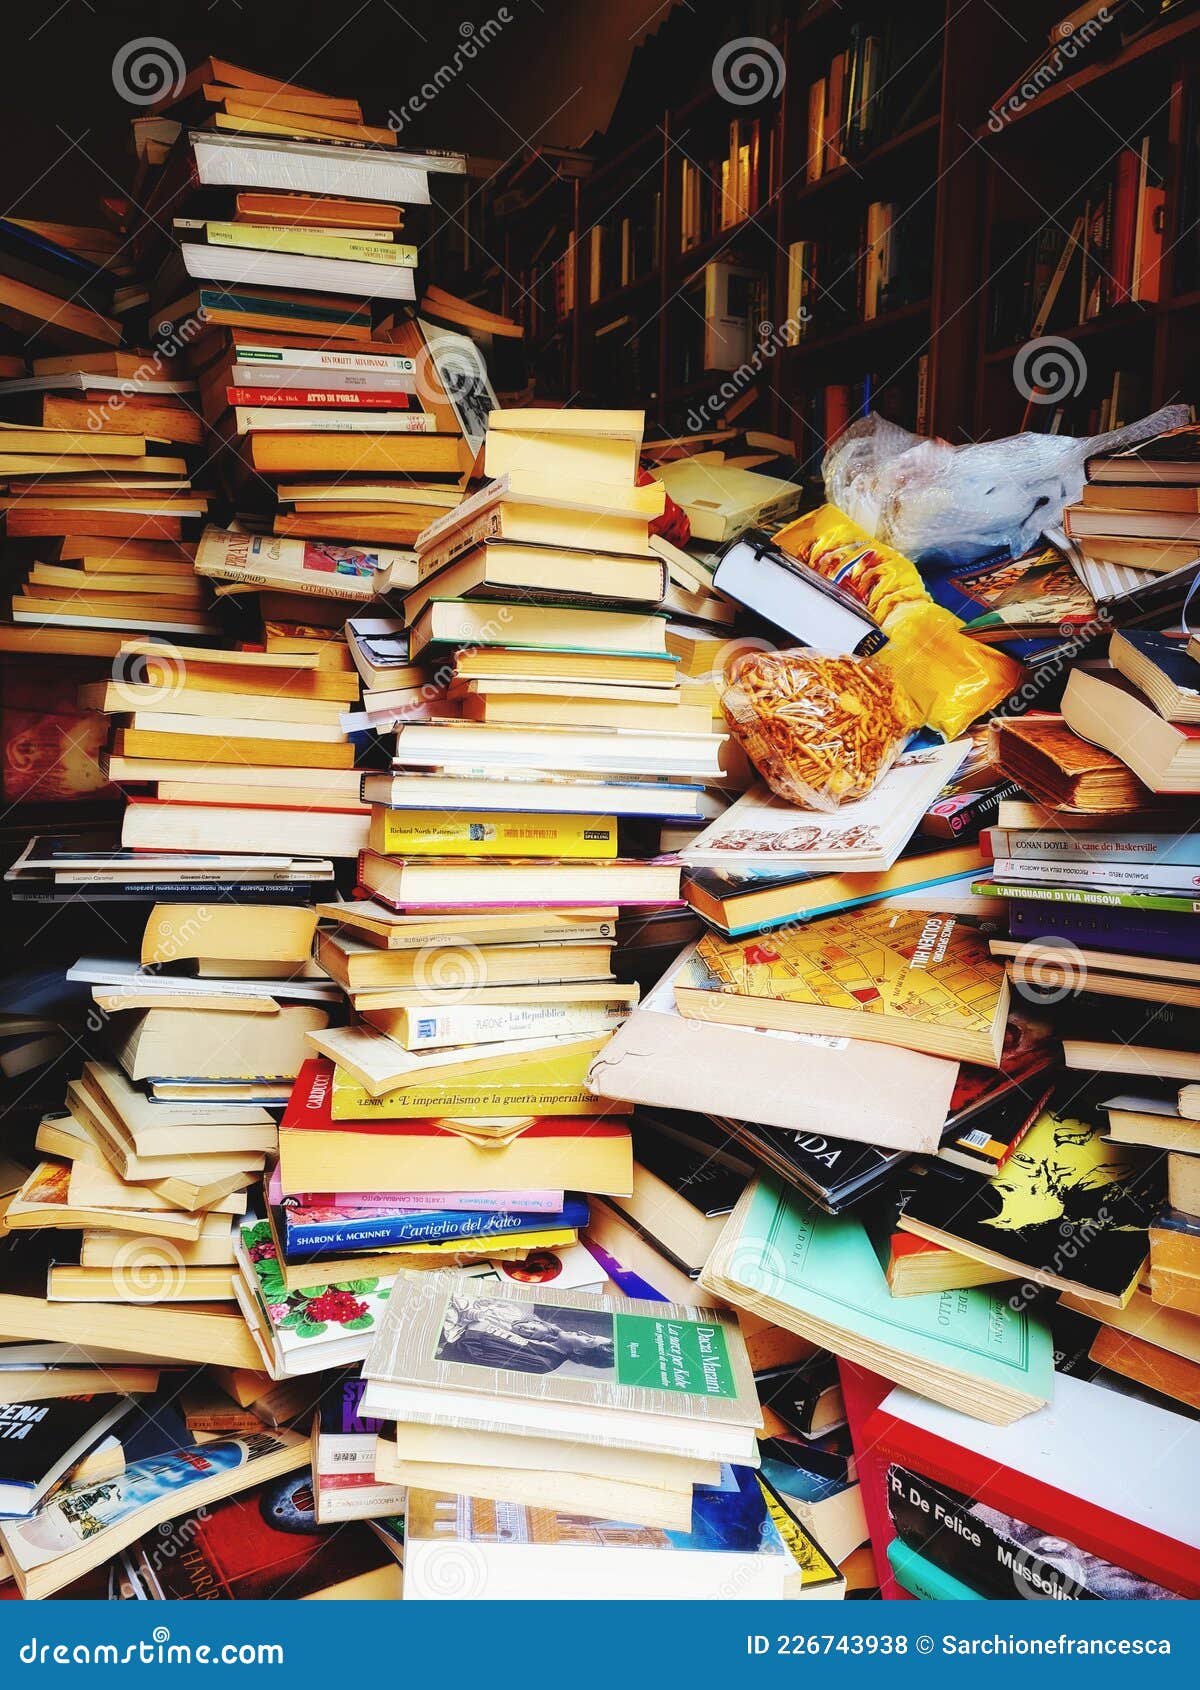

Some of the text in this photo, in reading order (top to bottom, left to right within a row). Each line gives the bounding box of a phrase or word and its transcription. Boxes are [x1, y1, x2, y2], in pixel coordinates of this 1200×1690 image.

[307, 393, 326, 402] ATTO
[327, 394, 334, 402] DI
[336, 394, 360, 403] FORZA
[224, 571, 267, 584] Candelora
[301, 584, 353, 600] PIRANDELLO
[1016, 841, 1042, 850] CONAN
[1043, 841, 1069, 850] DOYLE
[1115, 843, 1158, 852] Baskerville
[997, 887, 1054, 899] L'ANTIQUARIO
[1055, 891, 1064, 900] DI
[1065, 891, 1081, 901] VIA
[909, 918, 942, 970] GOLDEN HILL
[509, 1011, 519, 1021] La
[522, 1008, 566, 1021] Repubblica
[305, 1074, 331, 1109] CARDUCCI
[357, 1097, 385, 1106] LENIN
[491, 1094, 501, 1104] la
[503, 1096, 538, 1106] guerra
[539, 1093, 600, 1106] imperialista
[361, 1194, 411, 1203] CAMBIAMENTO
[425, 1196, 446, 1204] L'ARTE
[397, 1215, 522, 1240] L'artiglio del Falco
[296, 1229, 392, 1246] SHARON K. MCKINNEY
[938, 1288, 954, 1326] ALLO
[957, 1295, 968, 1313] DEL
[667, 1323, 683, 1334] La
[665, 1353, 683, 1368] per
[696, 1327, 727, 1394] Dacia Maraini
[672, 1368, 691, 1388] Kobe
[891, 1477, 983, 1547] R. De Felice
[996, 1545, 1079, 1600] Mussolin
